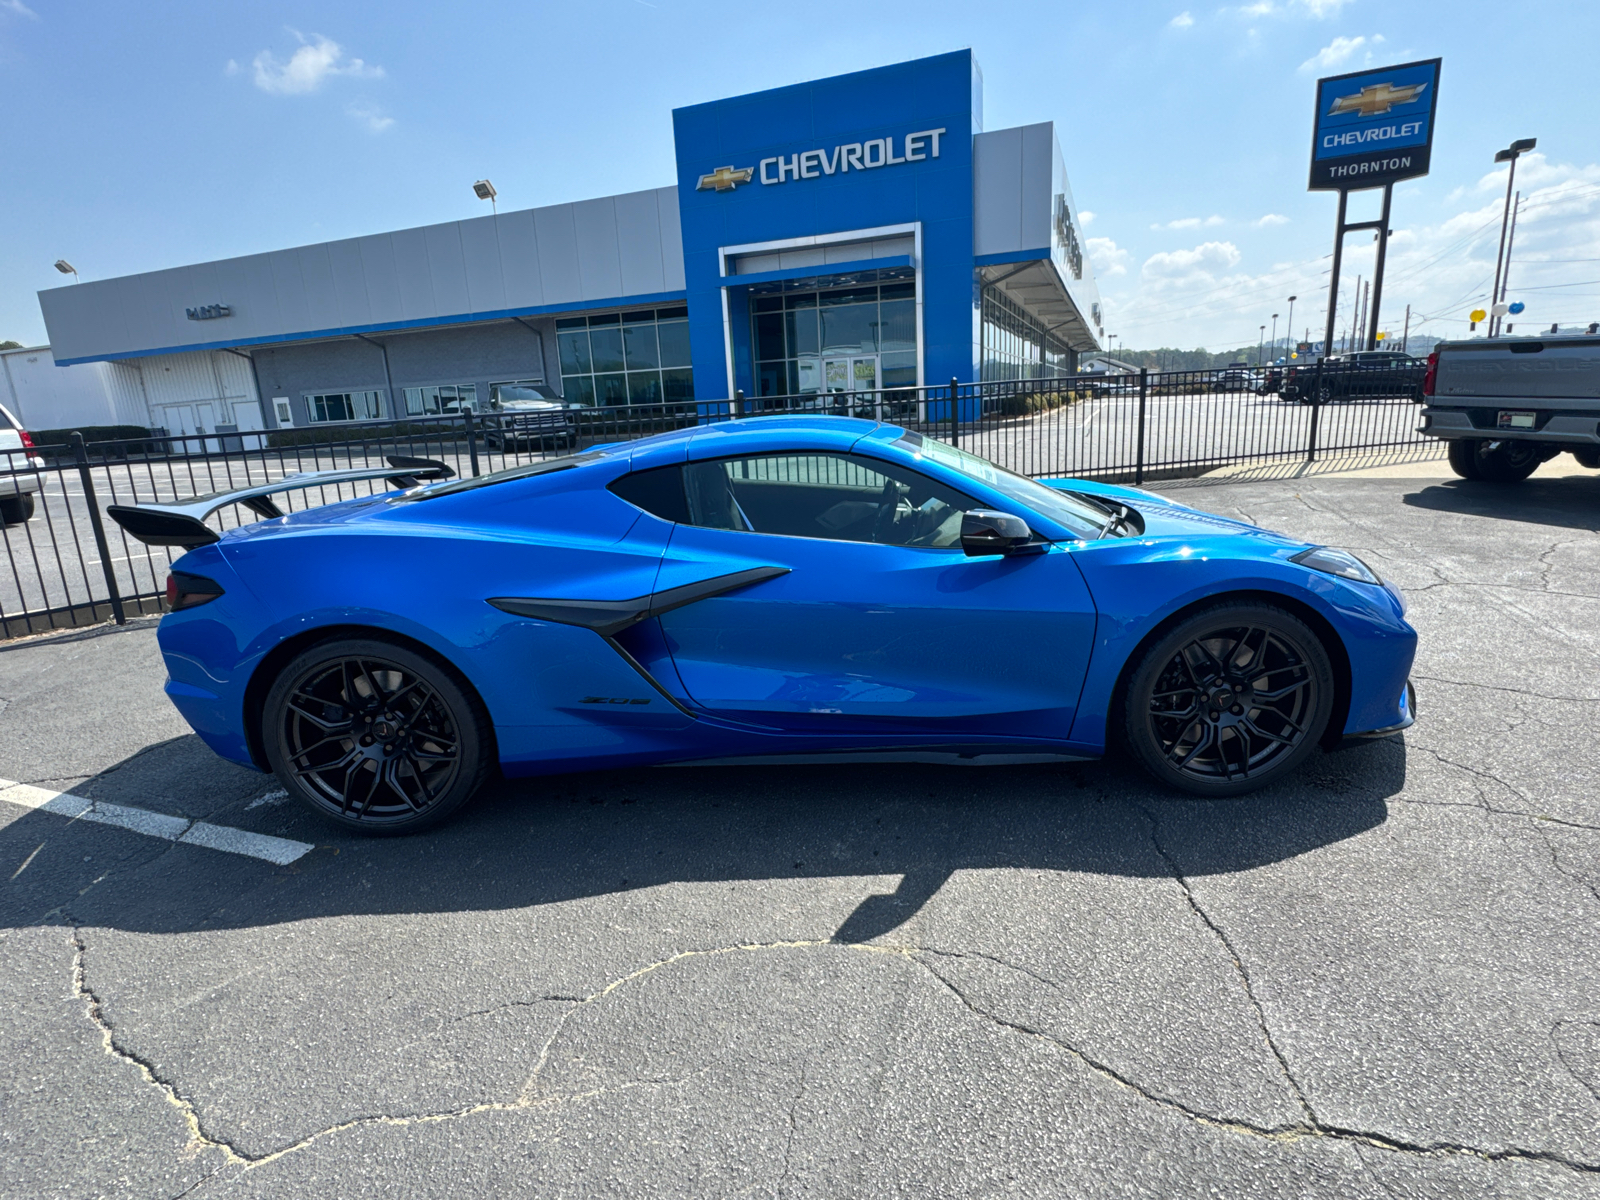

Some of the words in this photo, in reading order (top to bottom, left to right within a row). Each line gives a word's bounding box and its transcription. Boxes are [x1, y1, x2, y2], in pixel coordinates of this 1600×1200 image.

[1323, 122, 1422, 148] CHEVROLET
[759, 127, 946, 185] CHEVROLET
[1329, 156, 1411, 177] THORNTON
